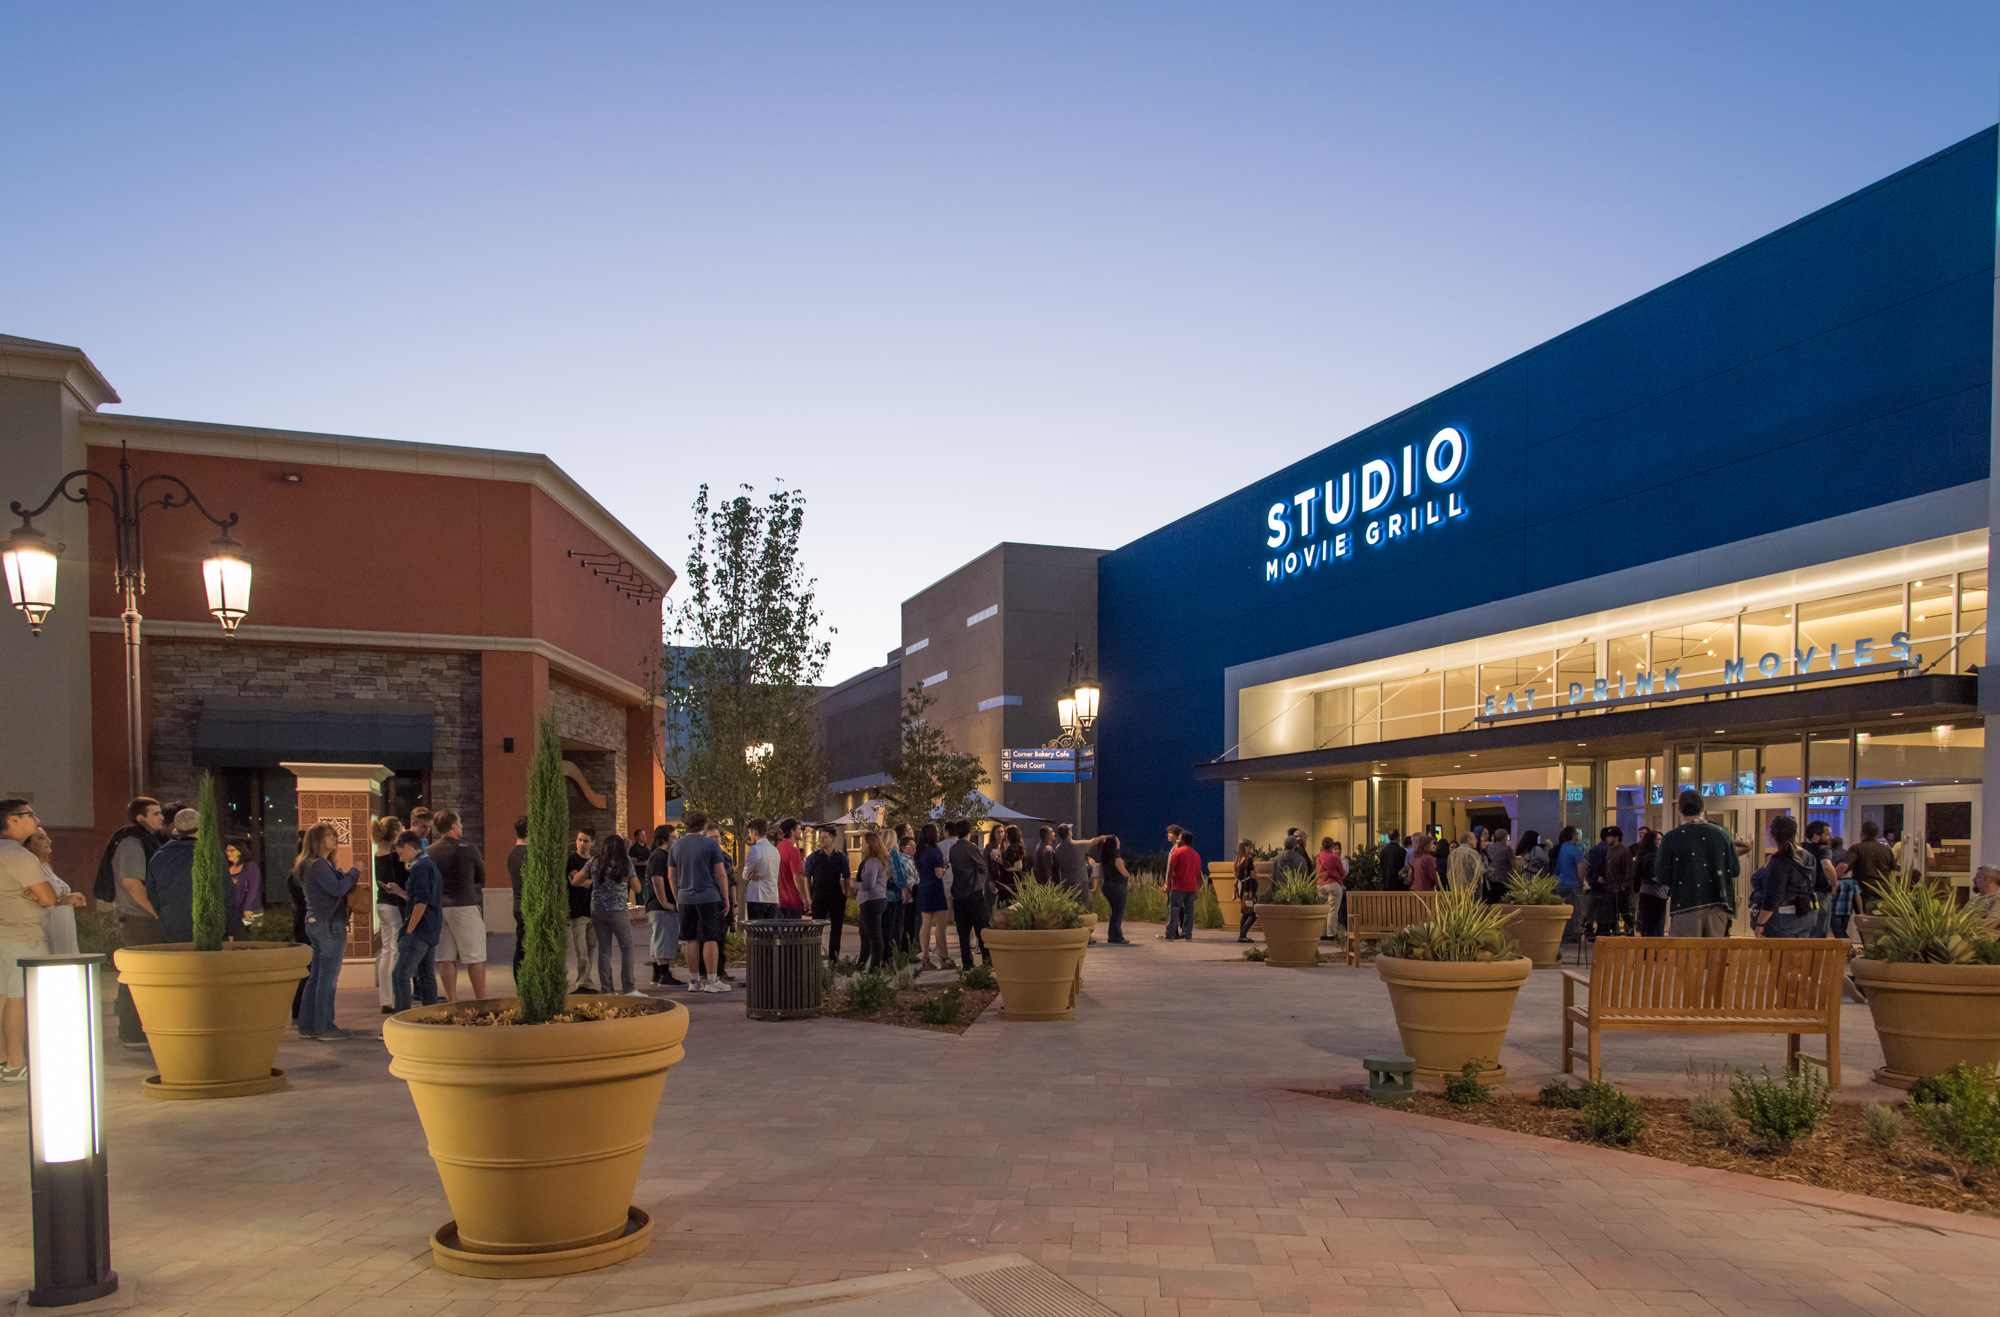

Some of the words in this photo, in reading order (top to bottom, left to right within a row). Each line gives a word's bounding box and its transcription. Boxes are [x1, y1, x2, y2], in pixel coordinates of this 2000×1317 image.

[1267, 427, 1465, 548] STUDIO
[1266, 533, 1347, 581] MOVIE
[1365, 492, 1463, 545] GRILL
[1485, 689, 1537, 715] EAT
[1568, 666, 1682, 704] DRINK
[1724, 632, 1911, 683] MOVIES
[1012, 750, 1033, 758] Corner
[1034, 750, 1055, 759] Bakery
[1056, 750, 1070, 758] Cafe
